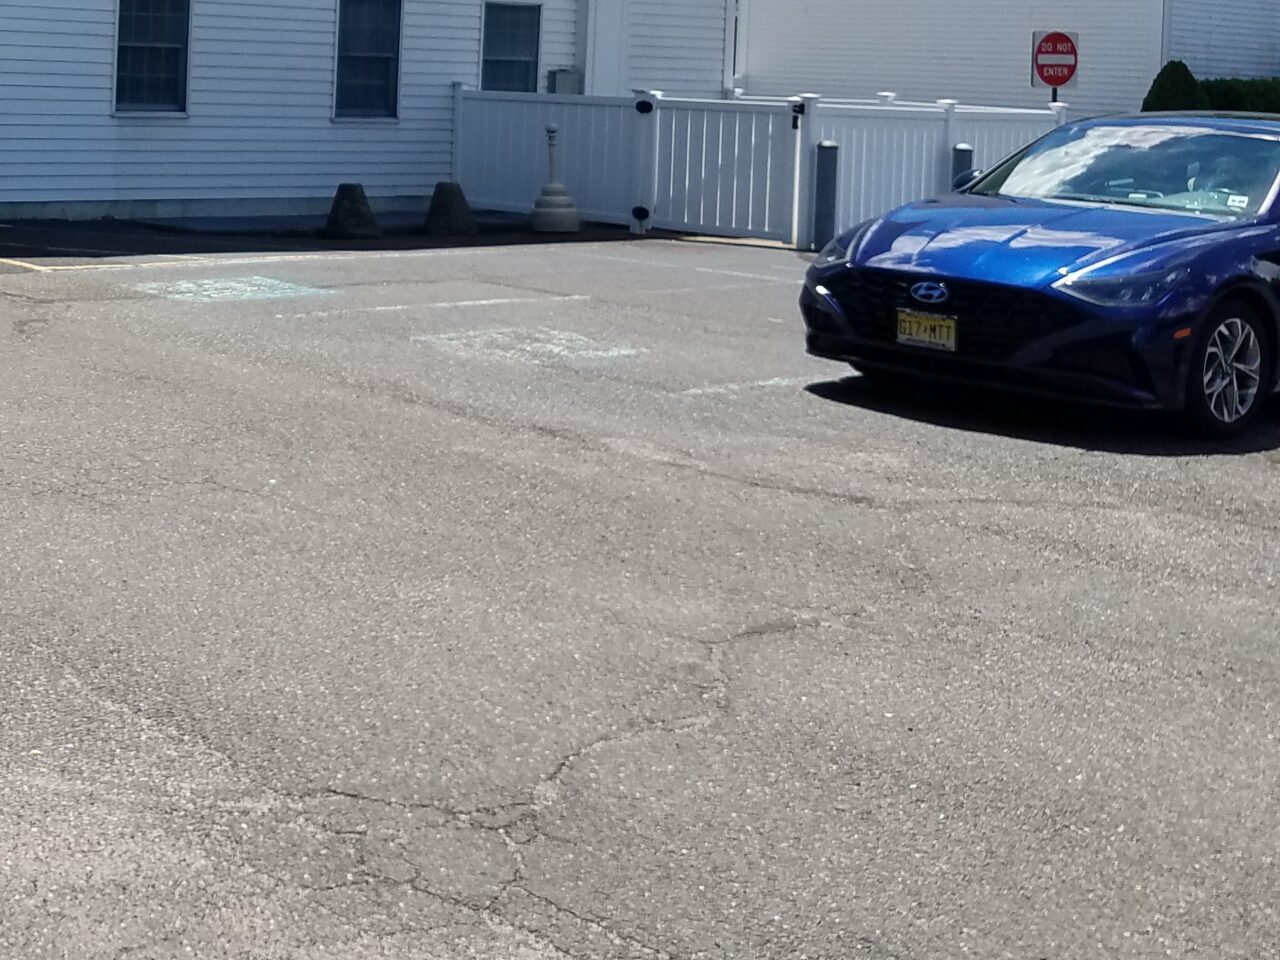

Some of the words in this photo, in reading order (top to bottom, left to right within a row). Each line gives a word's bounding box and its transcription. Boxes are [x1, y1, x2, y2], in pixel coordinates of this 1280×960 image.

[1041, 43, 1052, 51] DO
[1057, 43, 1072, 51] NOT
[1043, 66, 1068, 76] ENTER
